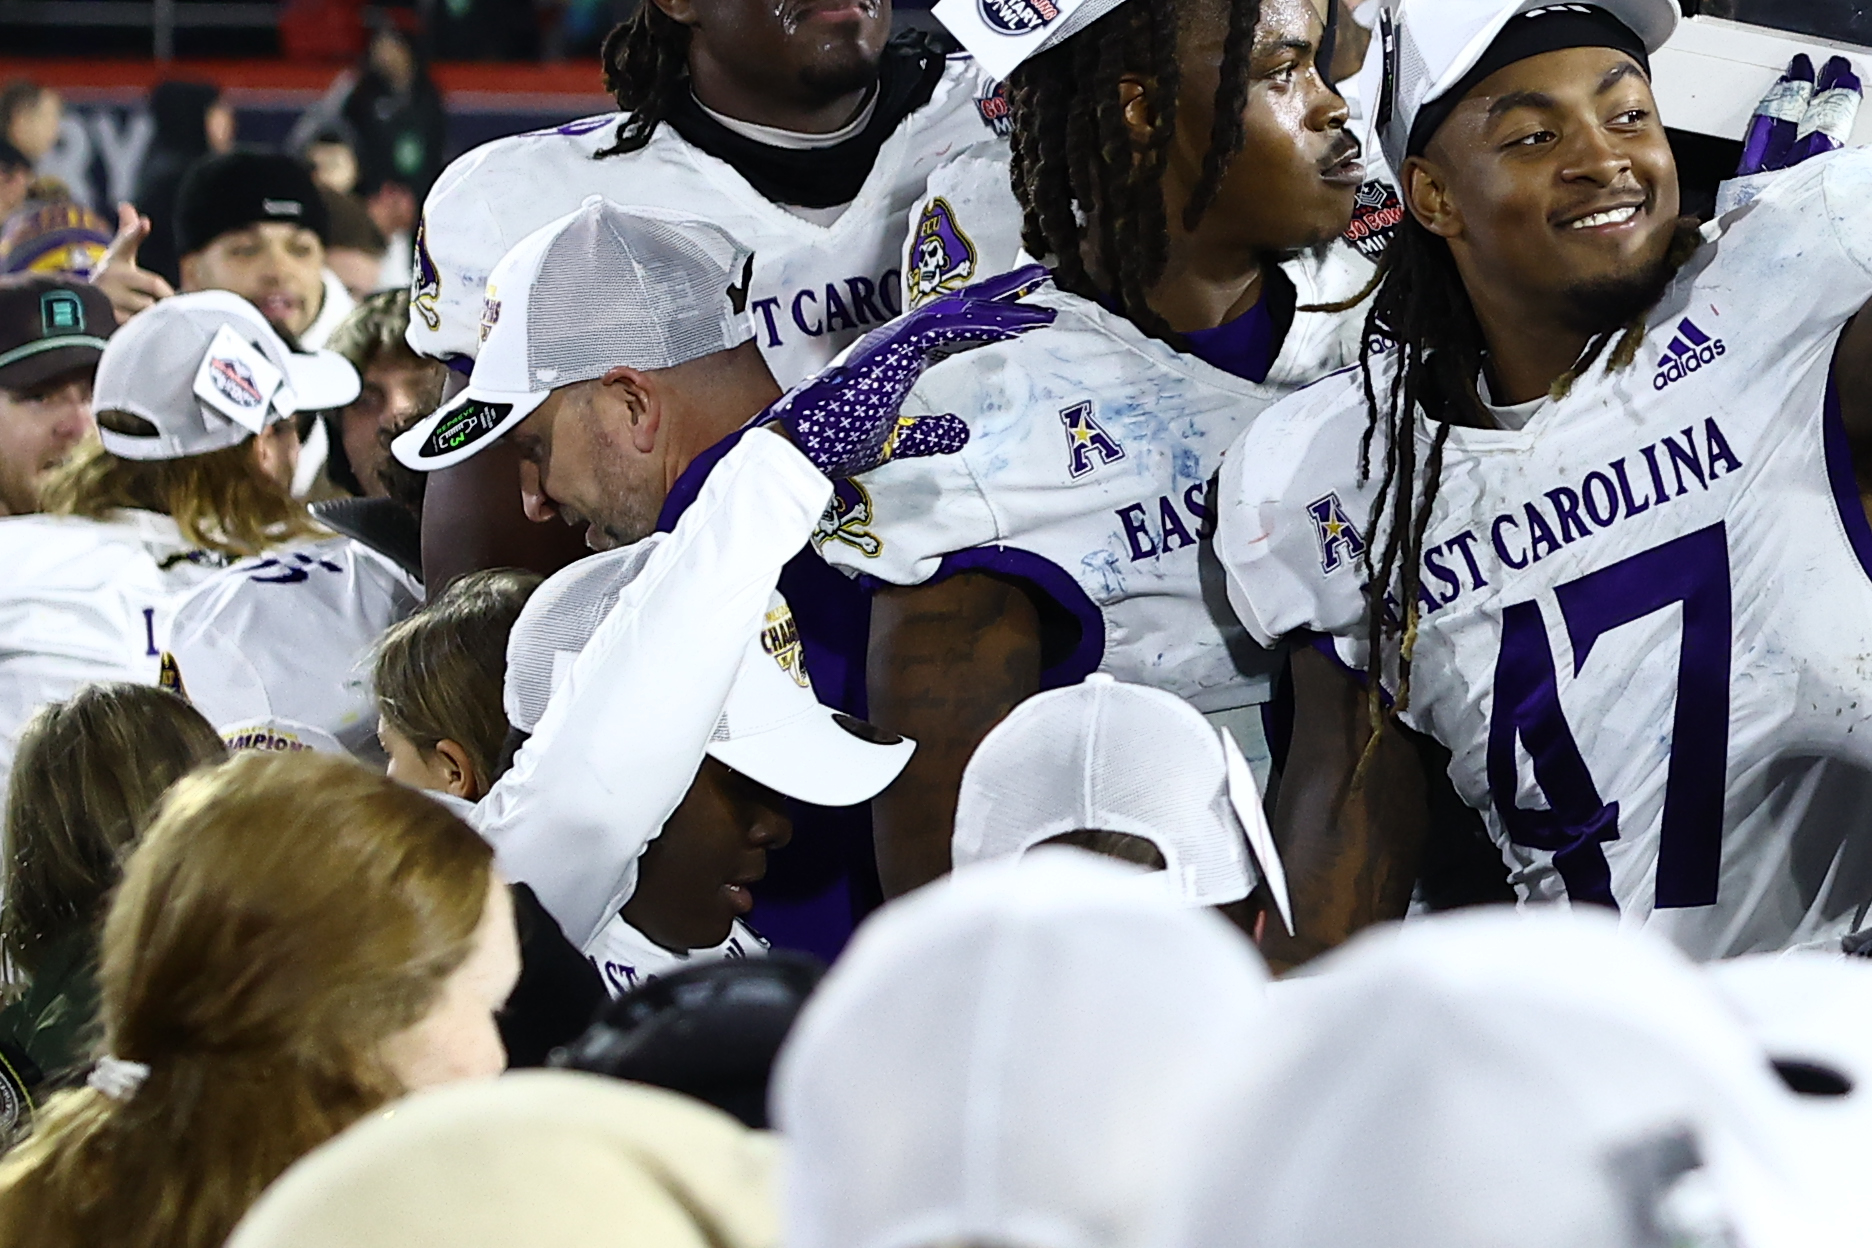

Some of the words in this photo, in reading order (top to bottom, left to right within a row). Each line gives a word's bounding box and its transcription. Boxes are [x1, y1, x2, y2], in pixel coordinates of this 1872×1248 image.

[1653, 338, 1726, 391] adidas
[1114, 477, 1219, 563] EAS
[1490, 416, 1743, 570] CAROLINA
[1487, 520, 1732, 914] 47
